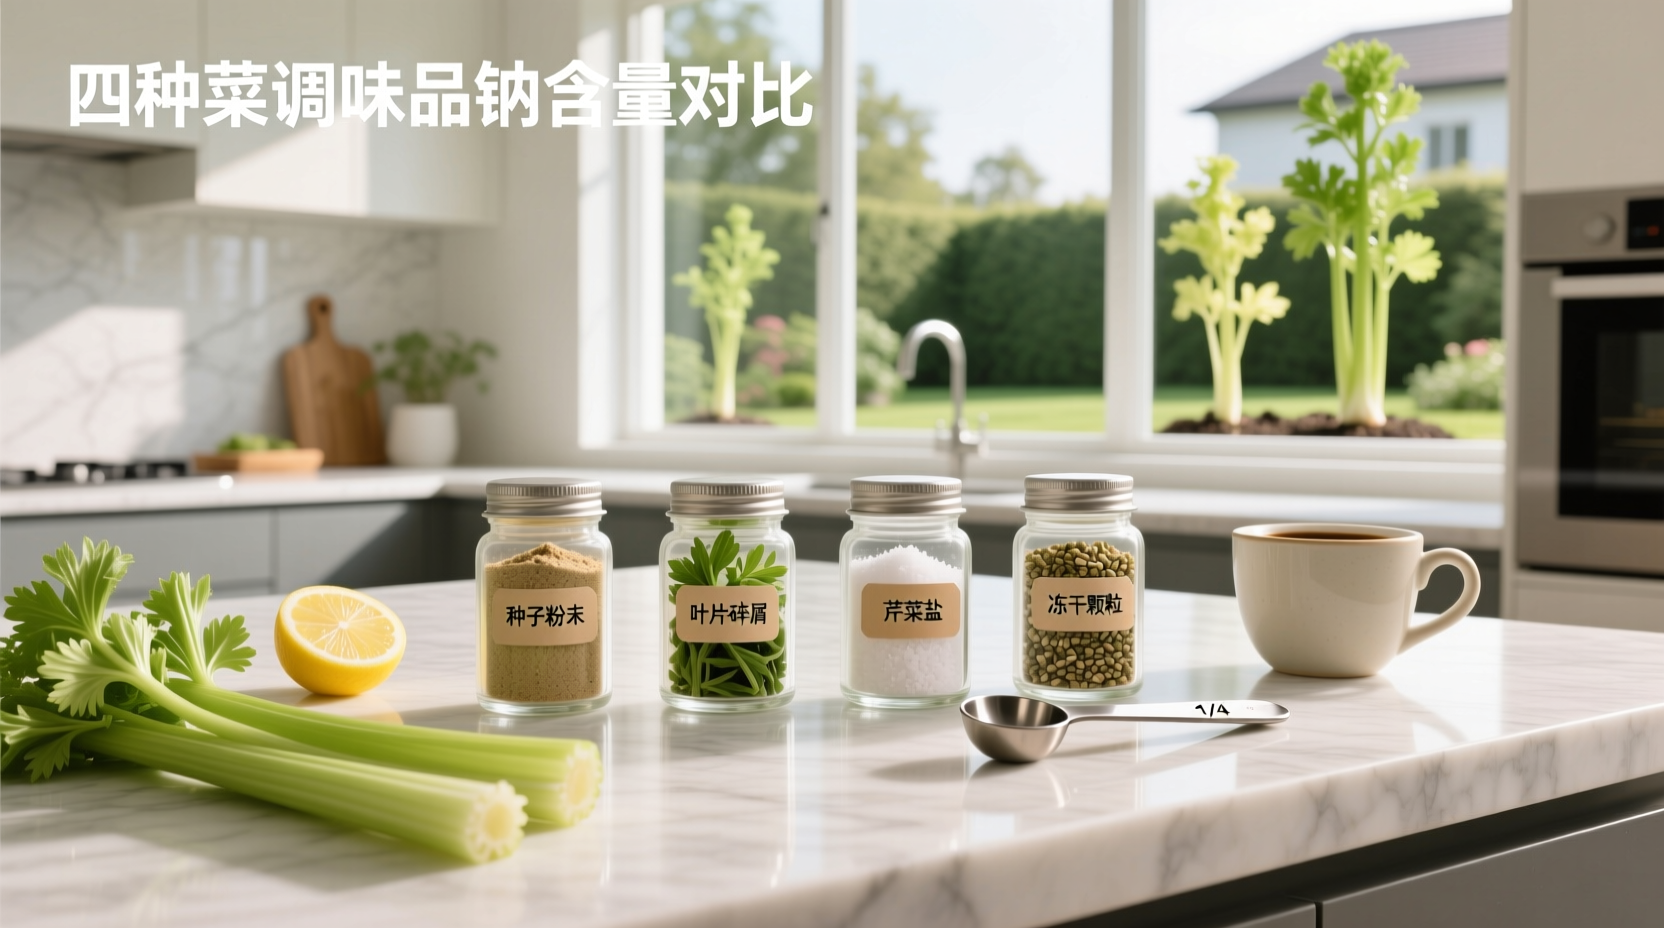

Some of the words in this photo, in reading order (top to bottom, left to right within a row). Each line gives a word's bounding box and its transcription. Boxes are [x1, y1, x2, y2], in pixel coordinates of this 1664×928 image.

[506, 604, 585, 627] 种子粉末
[690, 601, 767, 626] 叶片碎屑
[883, 599, 943, 622] 芹菜盐
[1048, 593, 1123, 615] 冻干颗粒
